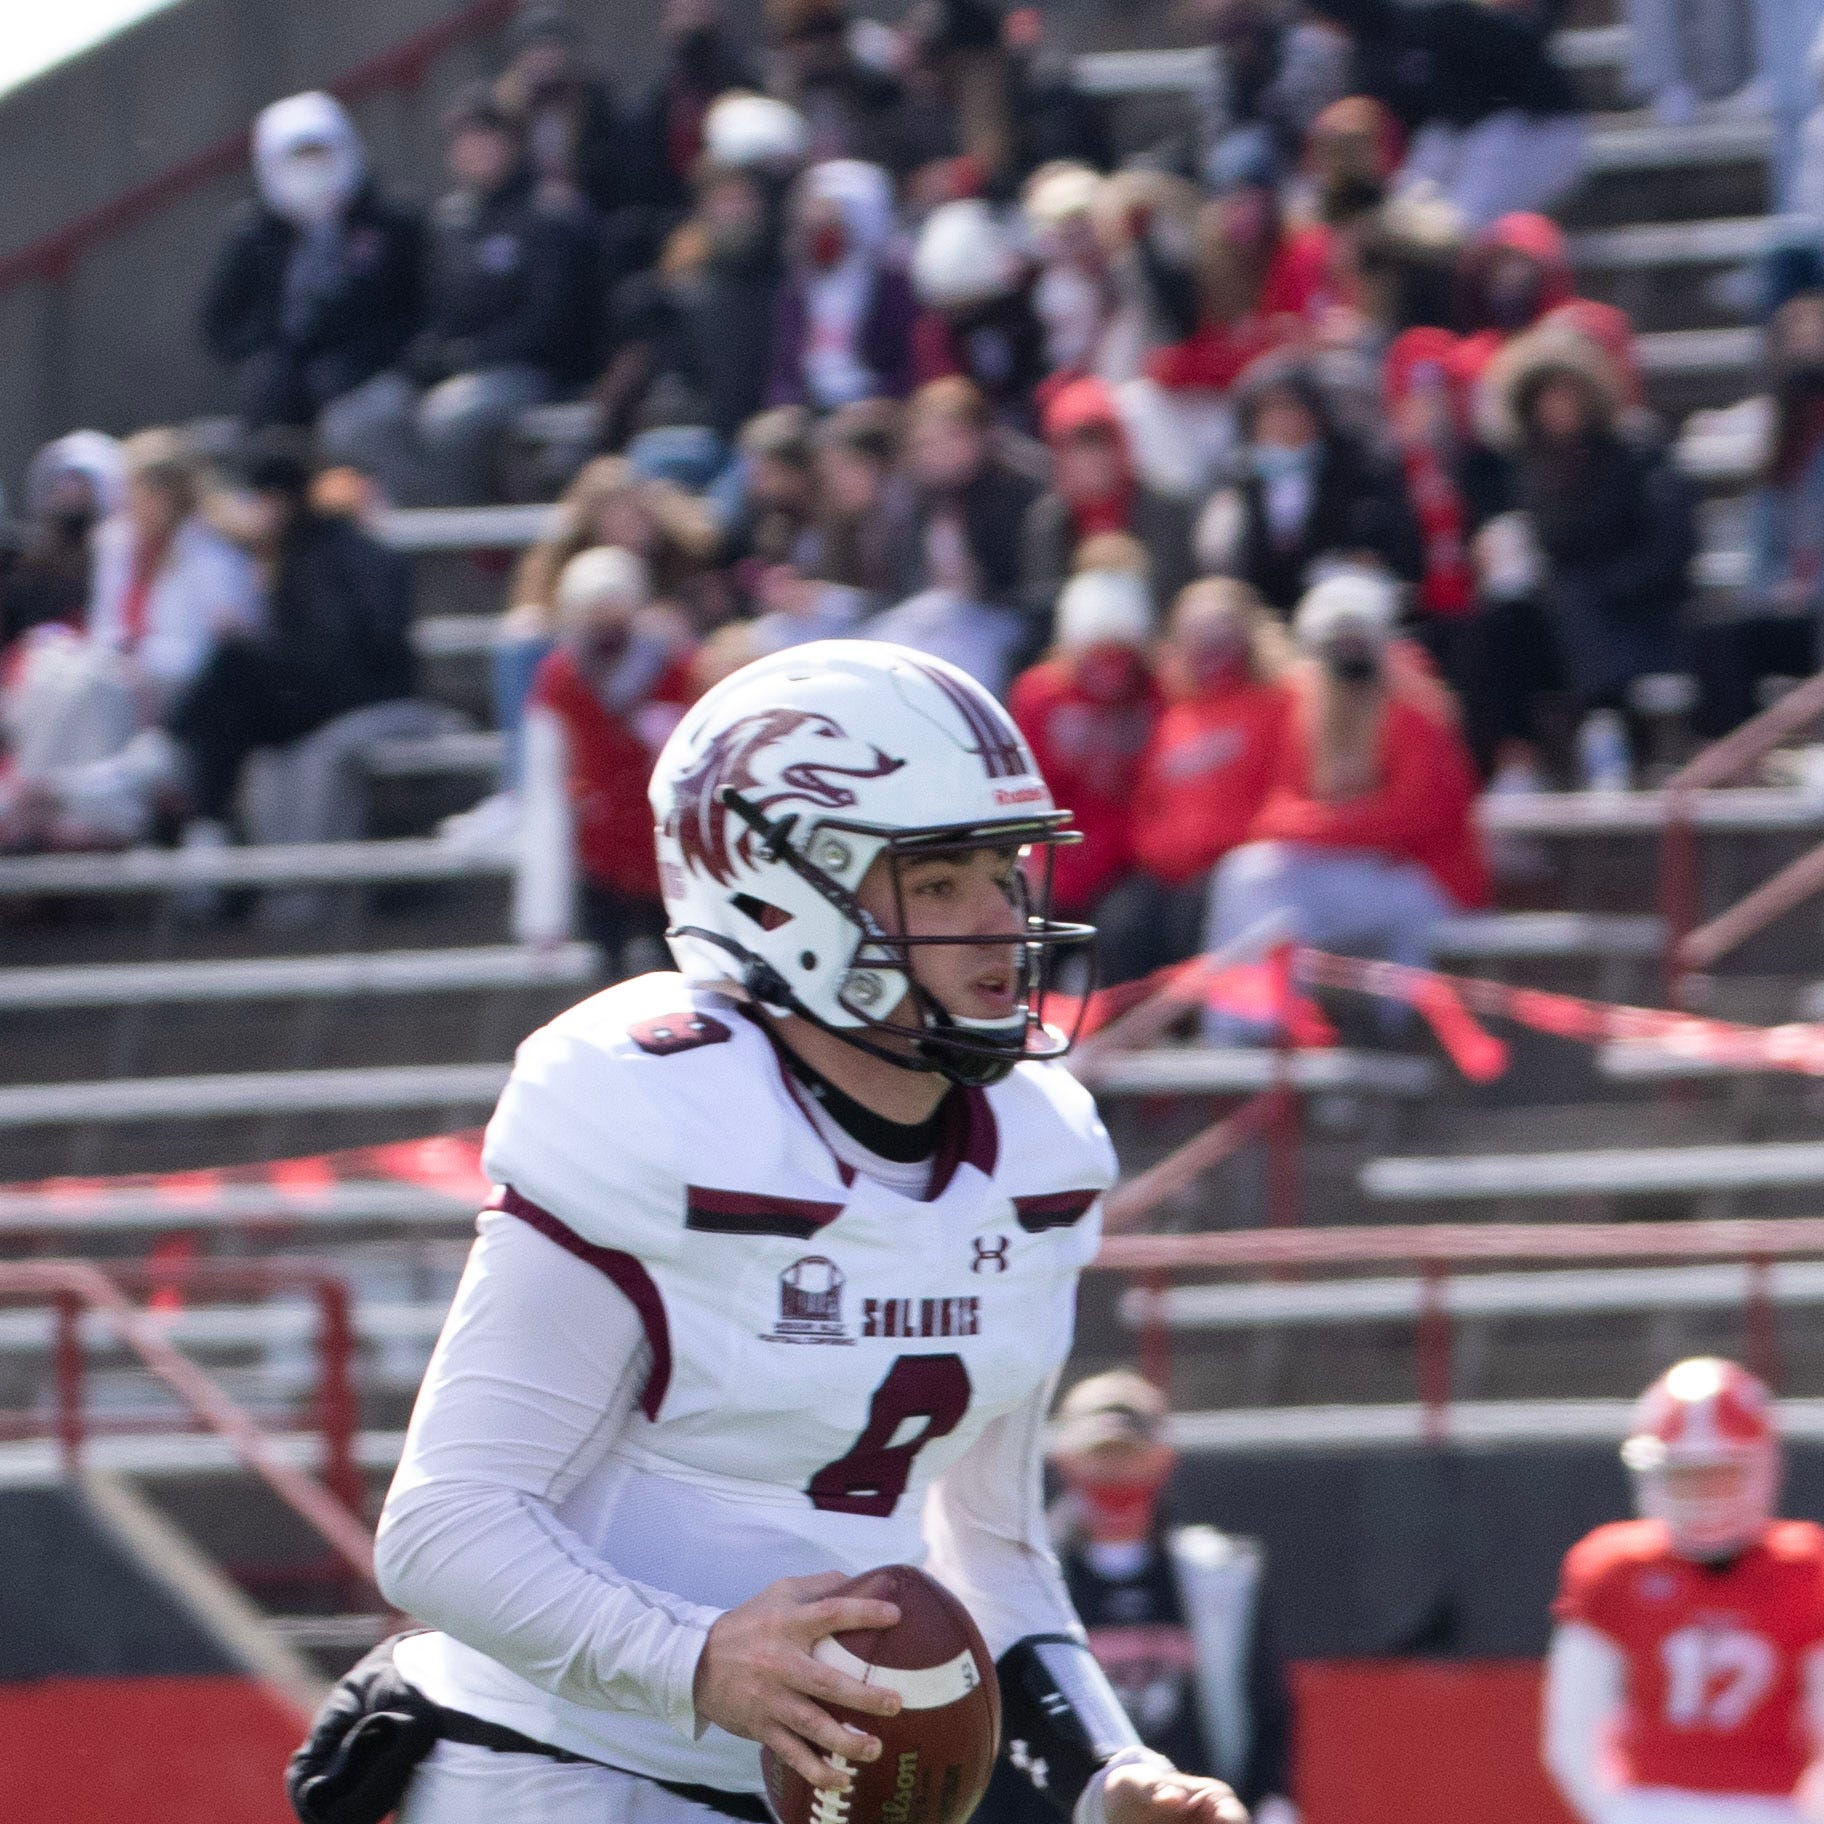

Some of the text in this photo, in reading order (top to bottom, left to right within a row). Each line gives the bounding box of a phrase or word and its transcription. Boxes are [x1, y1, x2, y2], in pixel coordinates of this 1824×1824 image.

[627, 1012, 733, 1056] 8
[804, 1354, 973, 1518] 8
[1664, 1622, 1778, 1728] 17
